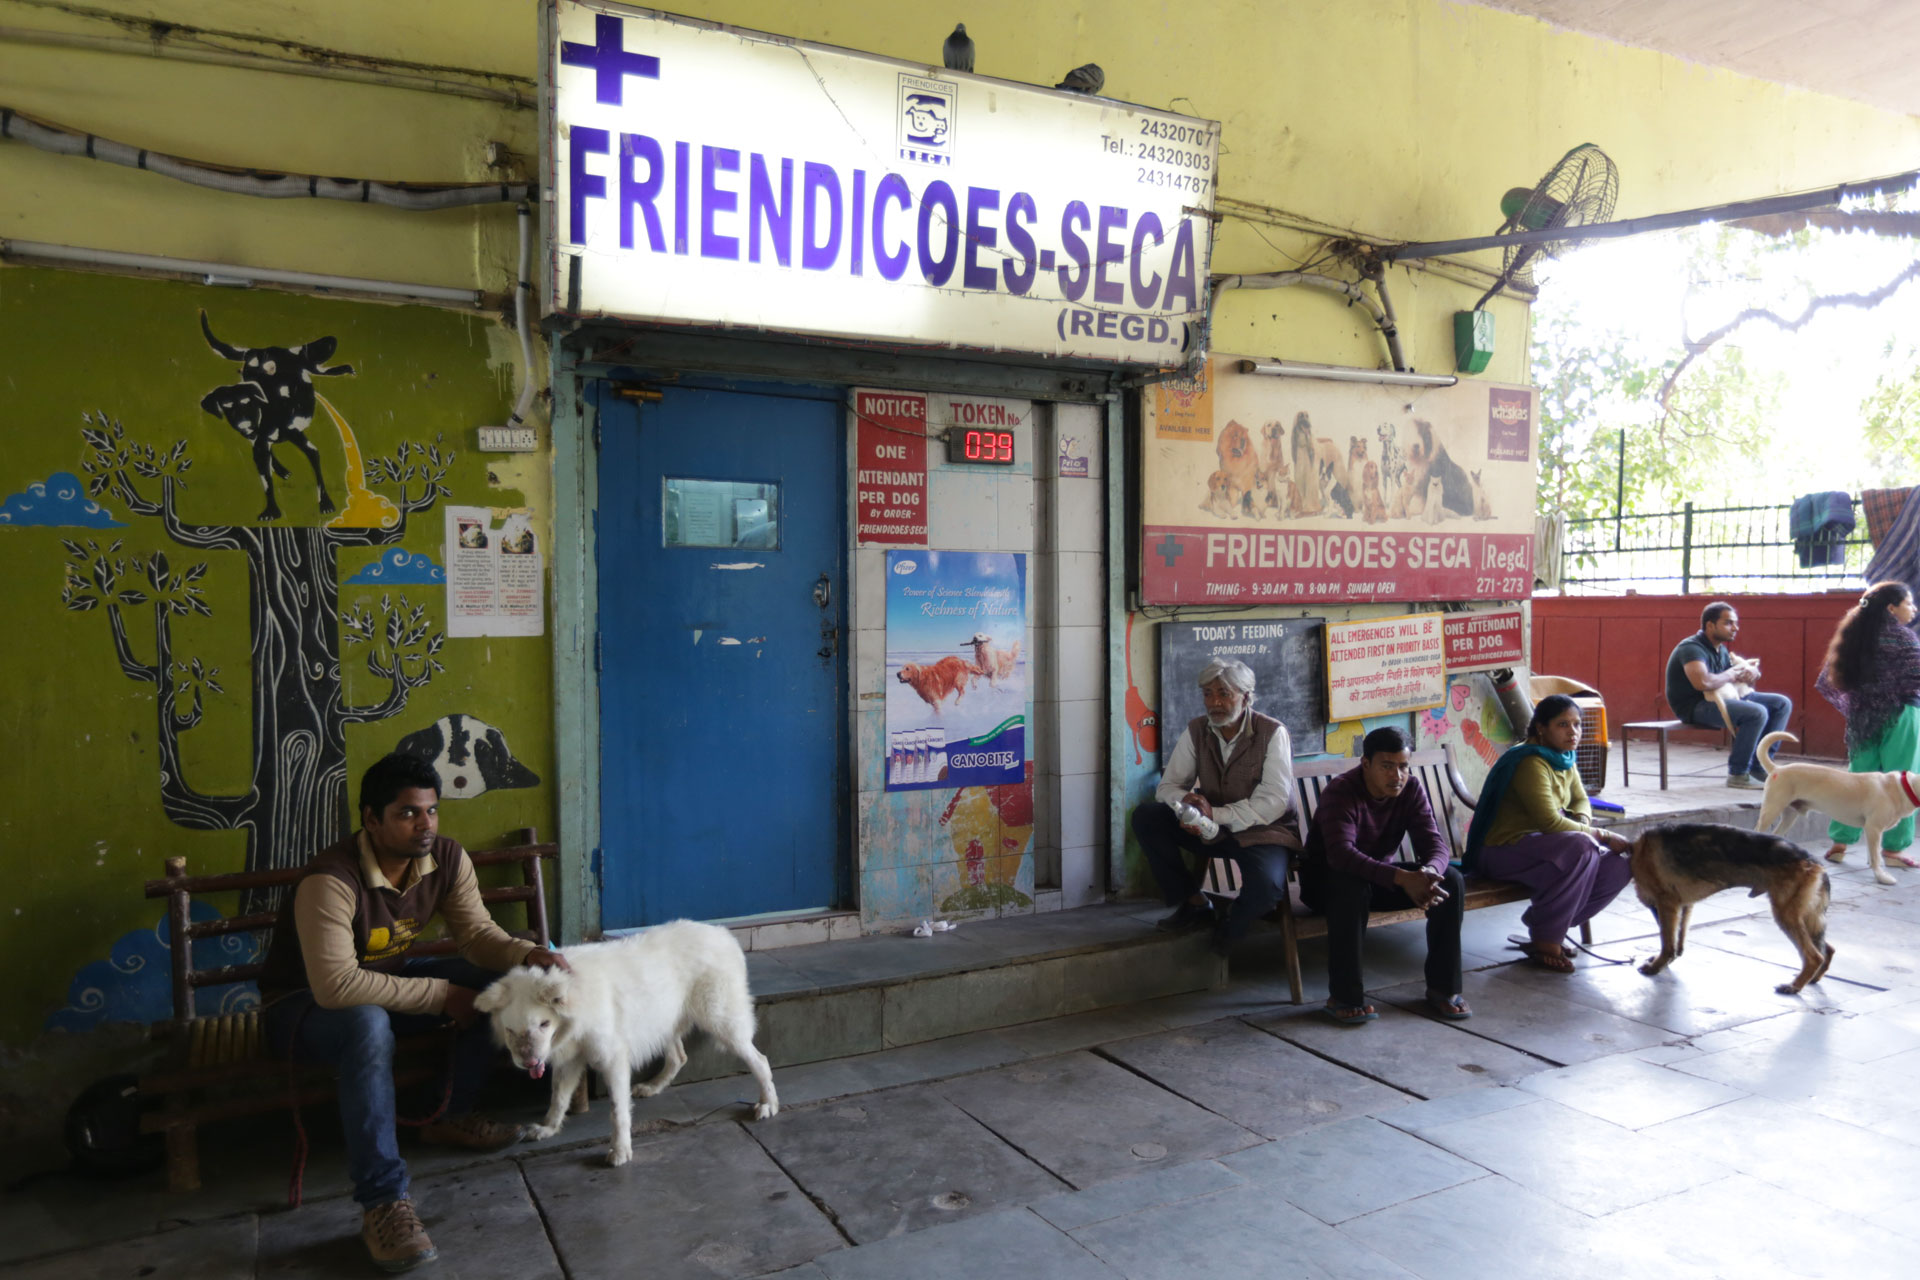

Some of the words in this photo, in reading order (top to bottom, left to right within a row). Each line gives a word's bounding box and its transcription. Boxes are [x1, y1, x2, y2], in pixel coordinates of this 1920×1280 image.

[902, 76, 954, 93] FRIENDICOES
[1140, 118, 1214, 149] 24320707
[1138, 142, 1211, 171] 24320303
[1137, 167, 1210, 195] 24314787
[569, 124, 1196, 313] FRIENDICOES-SECA
[1057, 308, 1190, 353] (REGD.)
[864, 397, 925, 419] NOTICE:
[949, 402, 1006, 426] TOKEN
[1491, 404, 1528, 421] whiskas
[1159, 424, 1193, 434] AVAILABLE
[1195, 427, 1212, 435] HERE
[875, 444, 907, 460] ONE
[964, 431, 1013, 461] 039
[858, 470, 925, 487] ATTENDANT
[859, 490, 885, 505] PER
[892, 491, 920, 506] DOG
[858, 523, 929, 536] FRIENDICOES-SECA
[1206, 533, 1471, 569] FRIENDICOES-SECA
[895, 562, 917, 575] Pfizer
[903, 586, 927, 598] Power
[927, 585, 937, 599] of
[937, 586, 963, 598] Science
[1273, 583, 1288, 595] AM
[1294, 583, 1304, 594] TO
[1328, 583, 1340, 595] PM
[1347, 583, 1375, 594] SUNDAY
[1377, 582, 1396, 594] OPEN
[1476, 577, 1524, 593] 271-273
[921, 600, 966, 618] Richness
[968, 600, 981, 621] of
[1192, 625, 1236, 642] TODAY'S
[1331, 632, 1345, 644] ALL
[1347, 626, 1395, 643] EMERGENCIES
[1399, 623, 1418, 637] WILL
[1423, 622, 1433, 635] BE
[1444, 622, 1465, 636] ONE
[1467, 616, 1520, 634] ATTENDANT
[1212, 645, 1256, 656] SPONSORED
[1331, 648, 1366, 663] ATTENDED
[1367, 644, 1386, 658] FIRST
[1386, 643, 1395, 655] ON
[1396, 640, 1421, 654] PRIORITY
[1422, 637, 1440, 651] BASIS
[1452, 637, 1473, 651] PER
[1478, 634, 1503, 652] DOG
[952, 752, 1014, 769] CANOBITS
